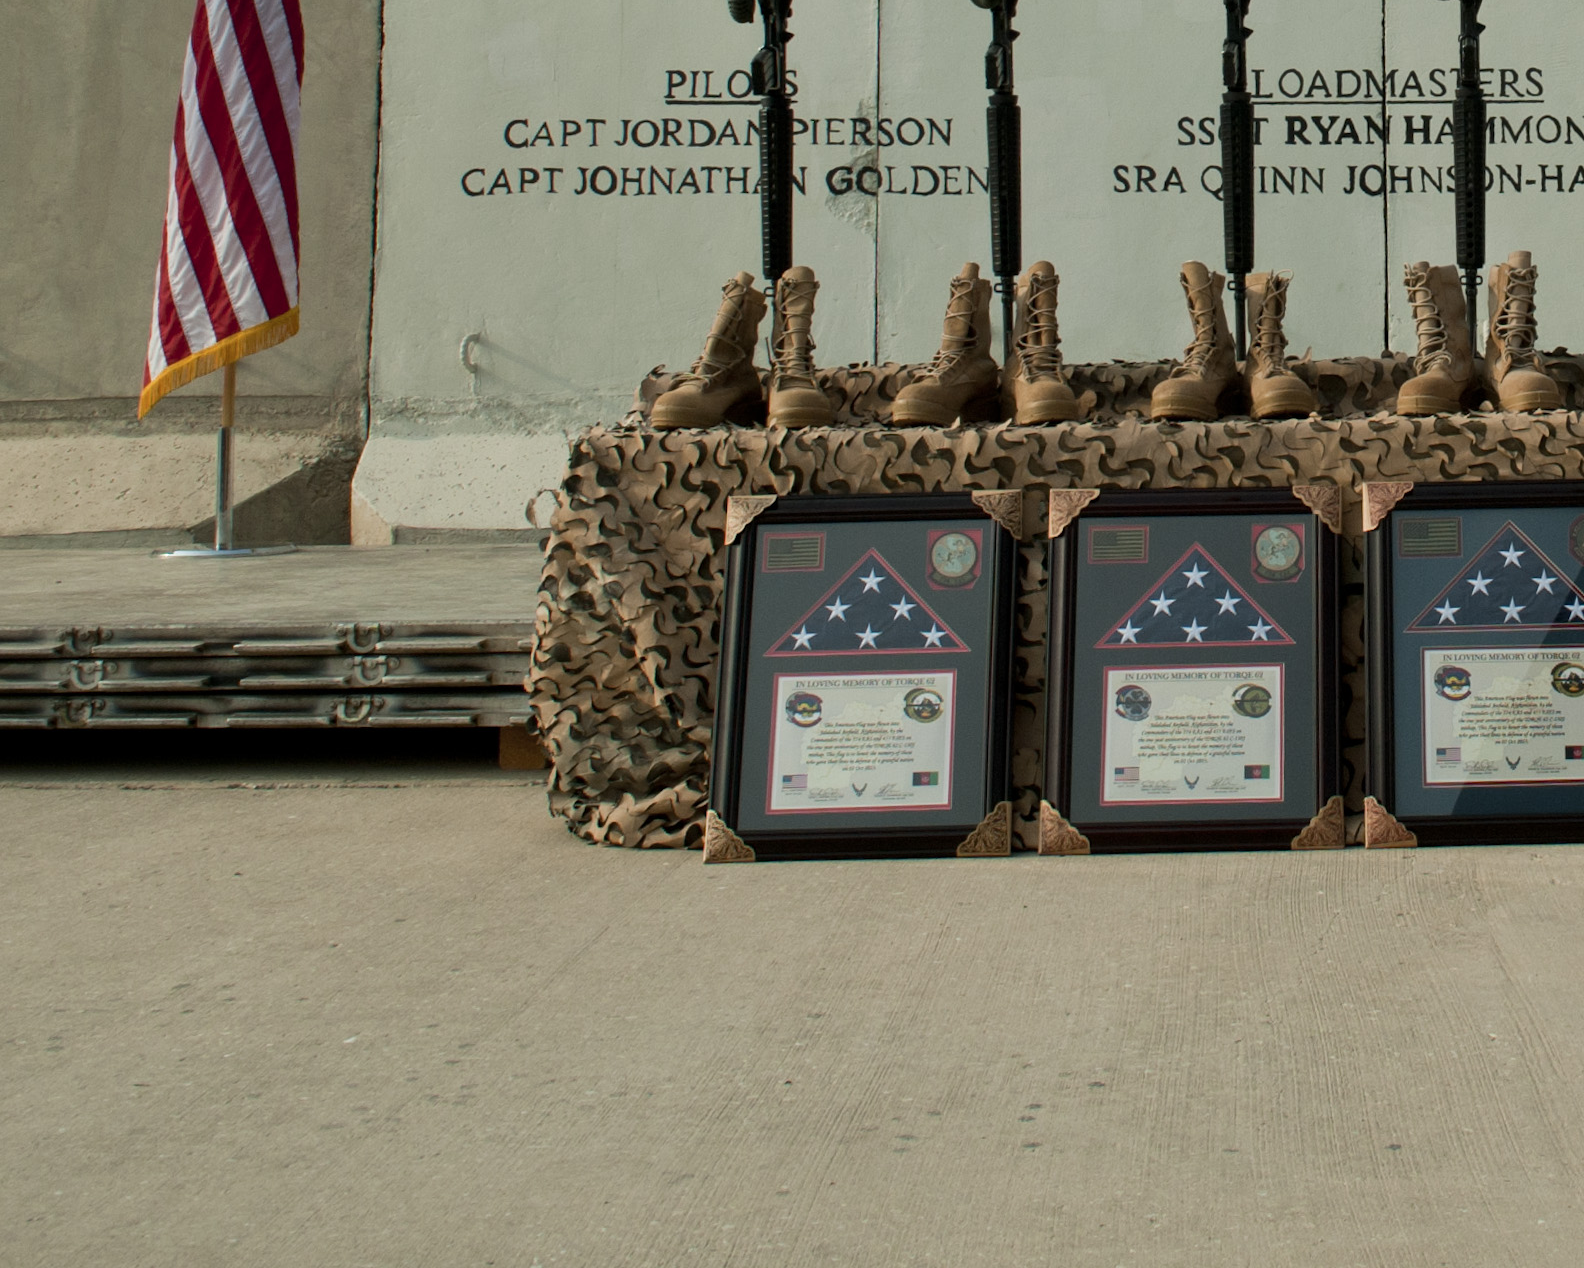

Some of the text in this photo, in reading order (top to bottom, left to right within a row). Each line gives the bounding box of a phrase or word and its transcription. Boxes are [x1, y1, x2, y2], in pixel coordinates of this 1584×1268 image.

[665, 69, 799, 99] PILOS
[504, 118, 606, 149] CAPT
[792, 117, 954, 147] PIERSON
[1177, 116, 1269, 146] SST
[1284, 114, 1391, 146] RYAN
[461, 165, 990, 197] CAPT JOHNATHN GOLDEN
[1112, 164, 1187, 194] SRA
[1200, 164, 1326, 201] QINN
[1454, 653, 1487, 661] LOVING
[1488, 653, 1526, 661] MEMORY
[807, 680, 840, 688] LOVING
[842, 679, 881, 687] MEMORY
[1136, 672, 1170, 680] LOVING
[1171, 672, 1209, 680] MEMORY
